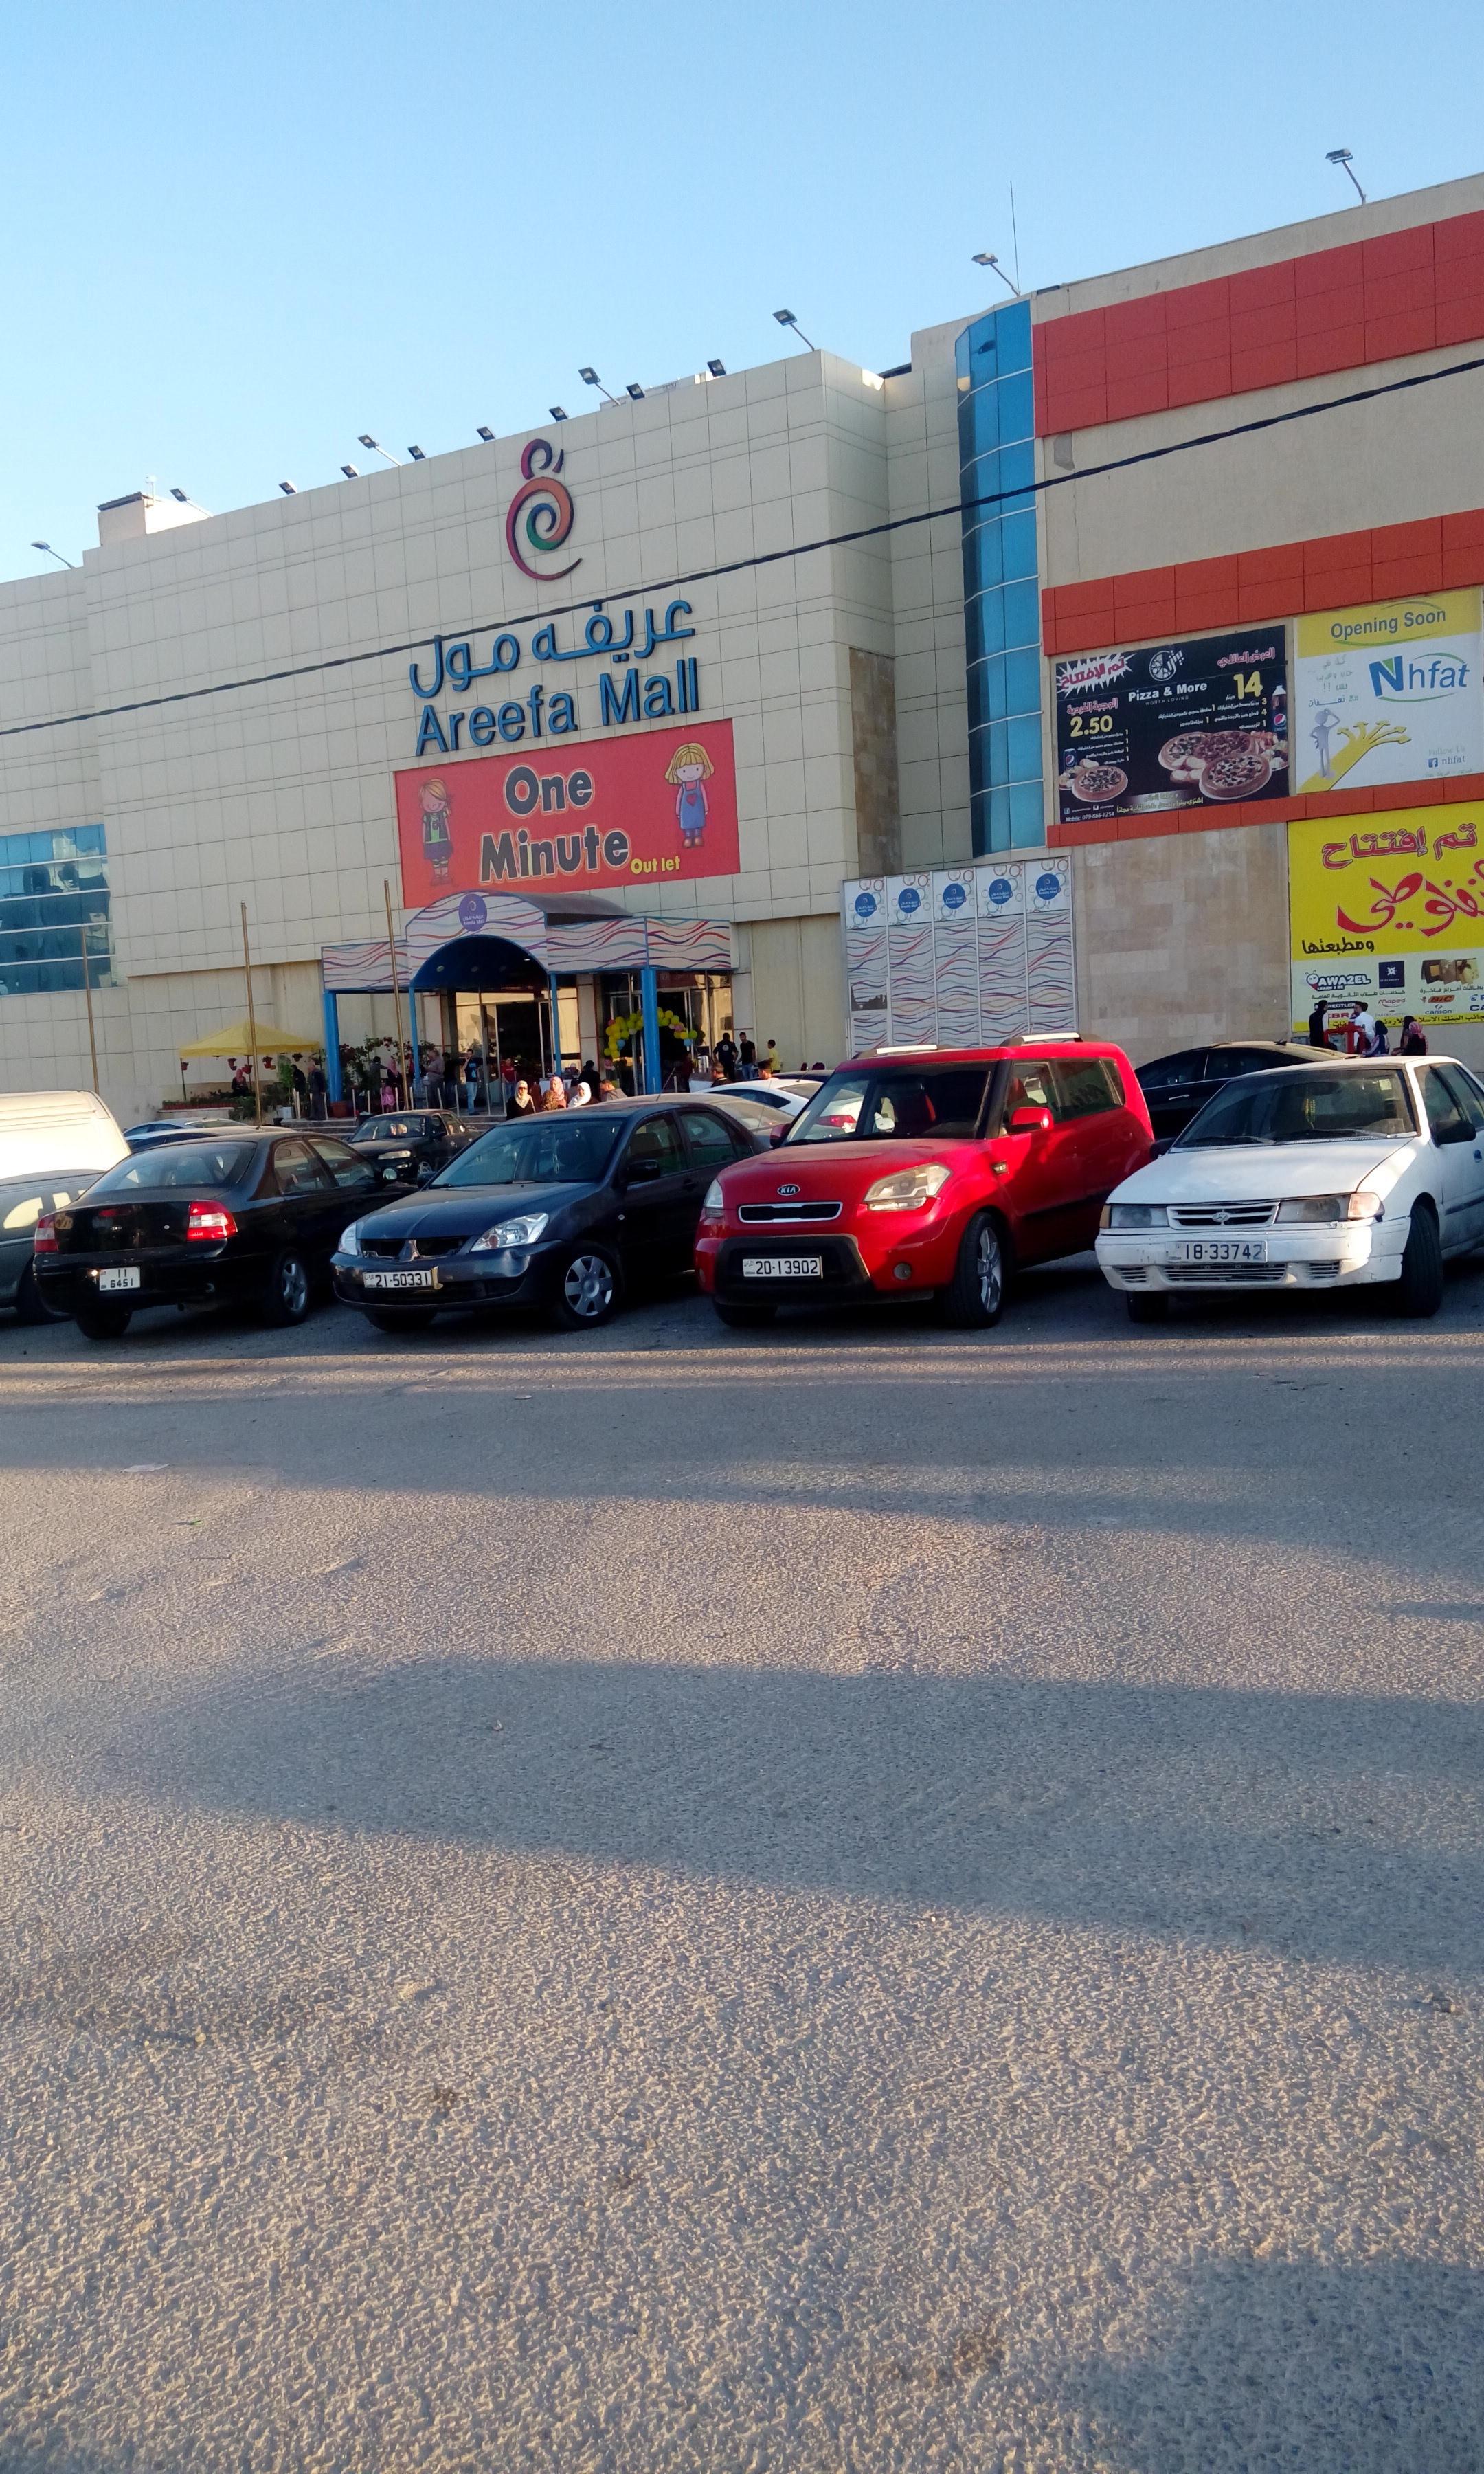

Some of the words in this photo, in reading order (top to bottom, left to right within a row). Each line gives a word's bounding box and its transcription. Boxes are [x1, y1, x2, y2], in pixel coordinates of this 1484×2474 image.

[1331, 617, 1397, 640] Opening
[1404, 610, 1446, 627] Soon
[409, 634, 519, 698] مول
[1108, 656, 1125, 675] تم
[1248, 647, 1275, 663] العرض
[1233, 671, 1263, 700] 14
[1369, 656, 1470, 698] Nhfat
[1129, 689, 1159, 702] Pizza
[1163, 687, 1173, 696] &
[1176, 682, 1207, 694] More
[416, 685, 578, 756] Areefa
[600, 657, 699, 726] Mall
[1070, 715, 1113, 737] 2.50
[505, 765, 593, 816] One
[480, 825, 629, 883] Minute
[631, 858, 657, 875] Out
[661, 856, 681, 872] let
[1322, 826, 1428, 870] إفتتاح
[1433, 823, 1477, 861] تم
[1318, 974, 1371, 988] AWA2EL
[1186, 1244, 1262, 1260] 18-33742
[375, 1273, 428, 1287] 21-50331
[756, 1260, 818, 1275] 20-13902
[110, 1278, 133, 1289] 6451
